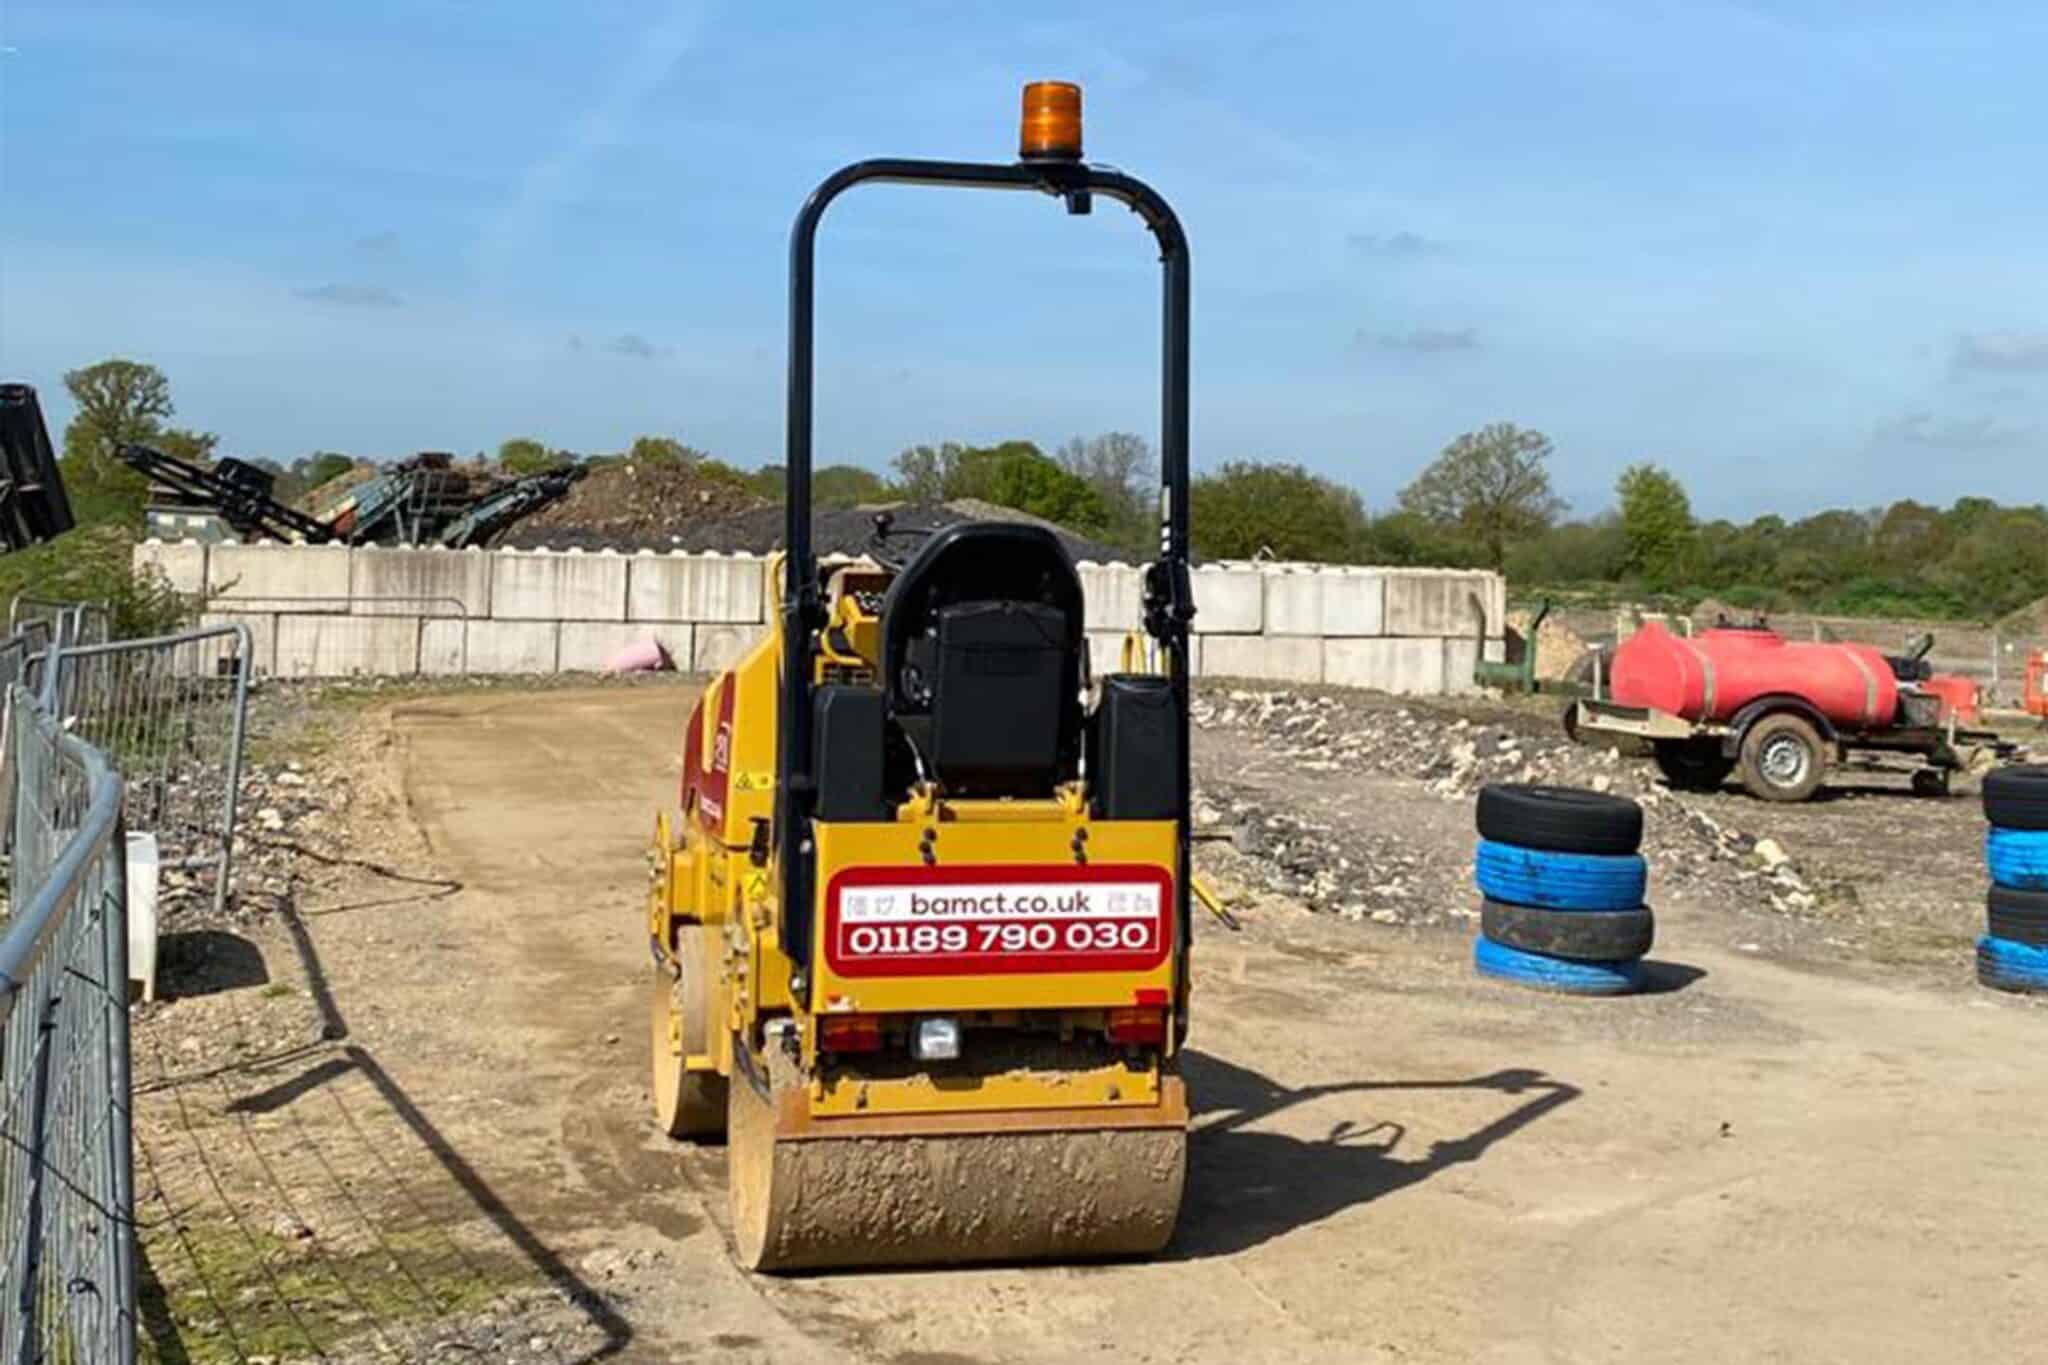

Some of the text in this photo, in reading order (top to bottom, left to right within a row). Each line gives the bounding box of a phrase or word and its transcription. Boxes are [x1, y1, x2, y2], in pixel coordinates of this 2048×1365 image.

[910, 890, 1092, 915] bamct.co.uk
[849, 921, 1150, 954] 01189 790 030
